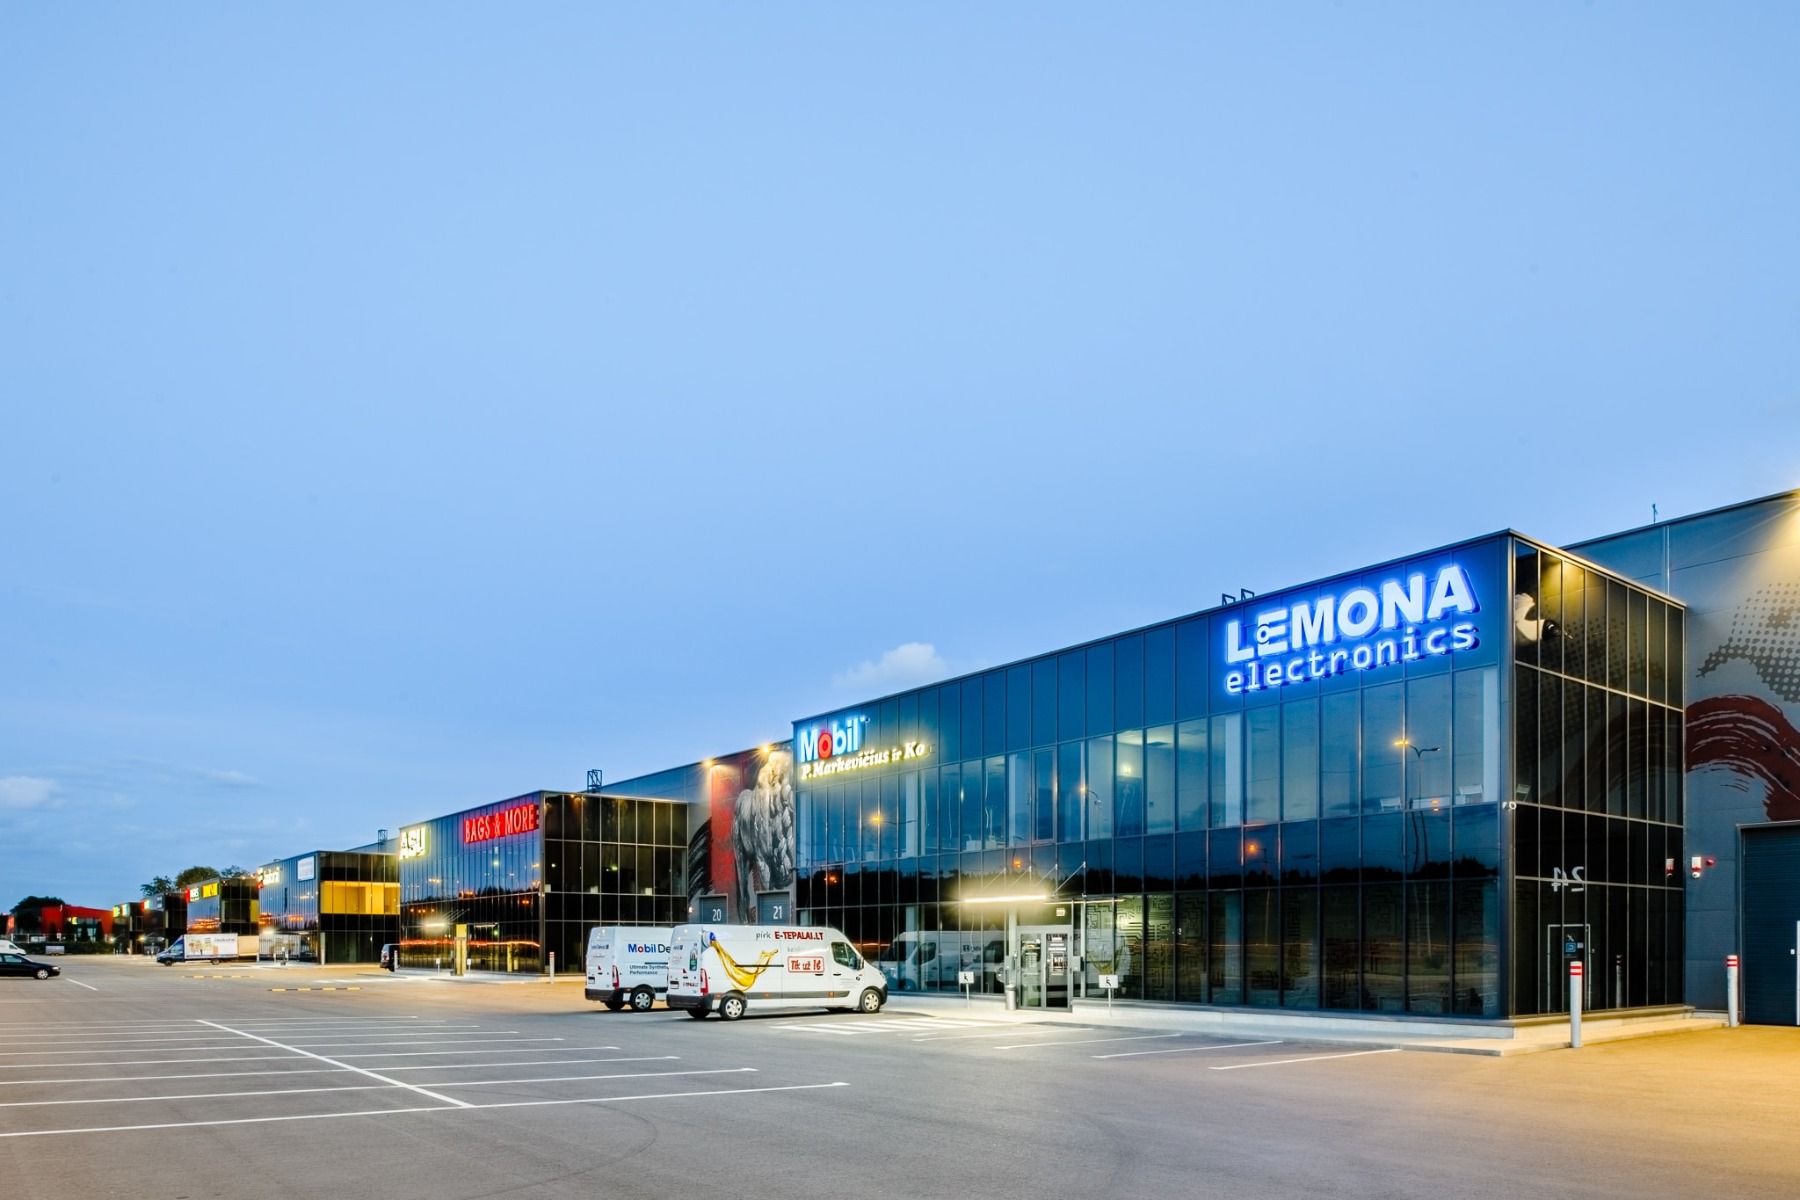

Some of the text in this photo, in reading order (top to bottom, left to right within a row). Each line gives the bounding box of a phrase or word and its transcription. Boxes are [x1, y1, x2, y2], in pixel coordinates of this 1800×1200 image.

[1227, 565, 1478, 663] LEMONA
[1226, 623, 1478, 694] electronics
[801, 719, 859, 762] Mobil
[904, 741, 925, 759] Ko
[465, 803, 535, 843] BAGS & MORE
[712, 908, 722, 922] 20
[773, 905, 783, 920] 21
[756, 931, 824, 940] pirk E-TEPALAI.LT
[628, 943, 656, 953] Mobil
